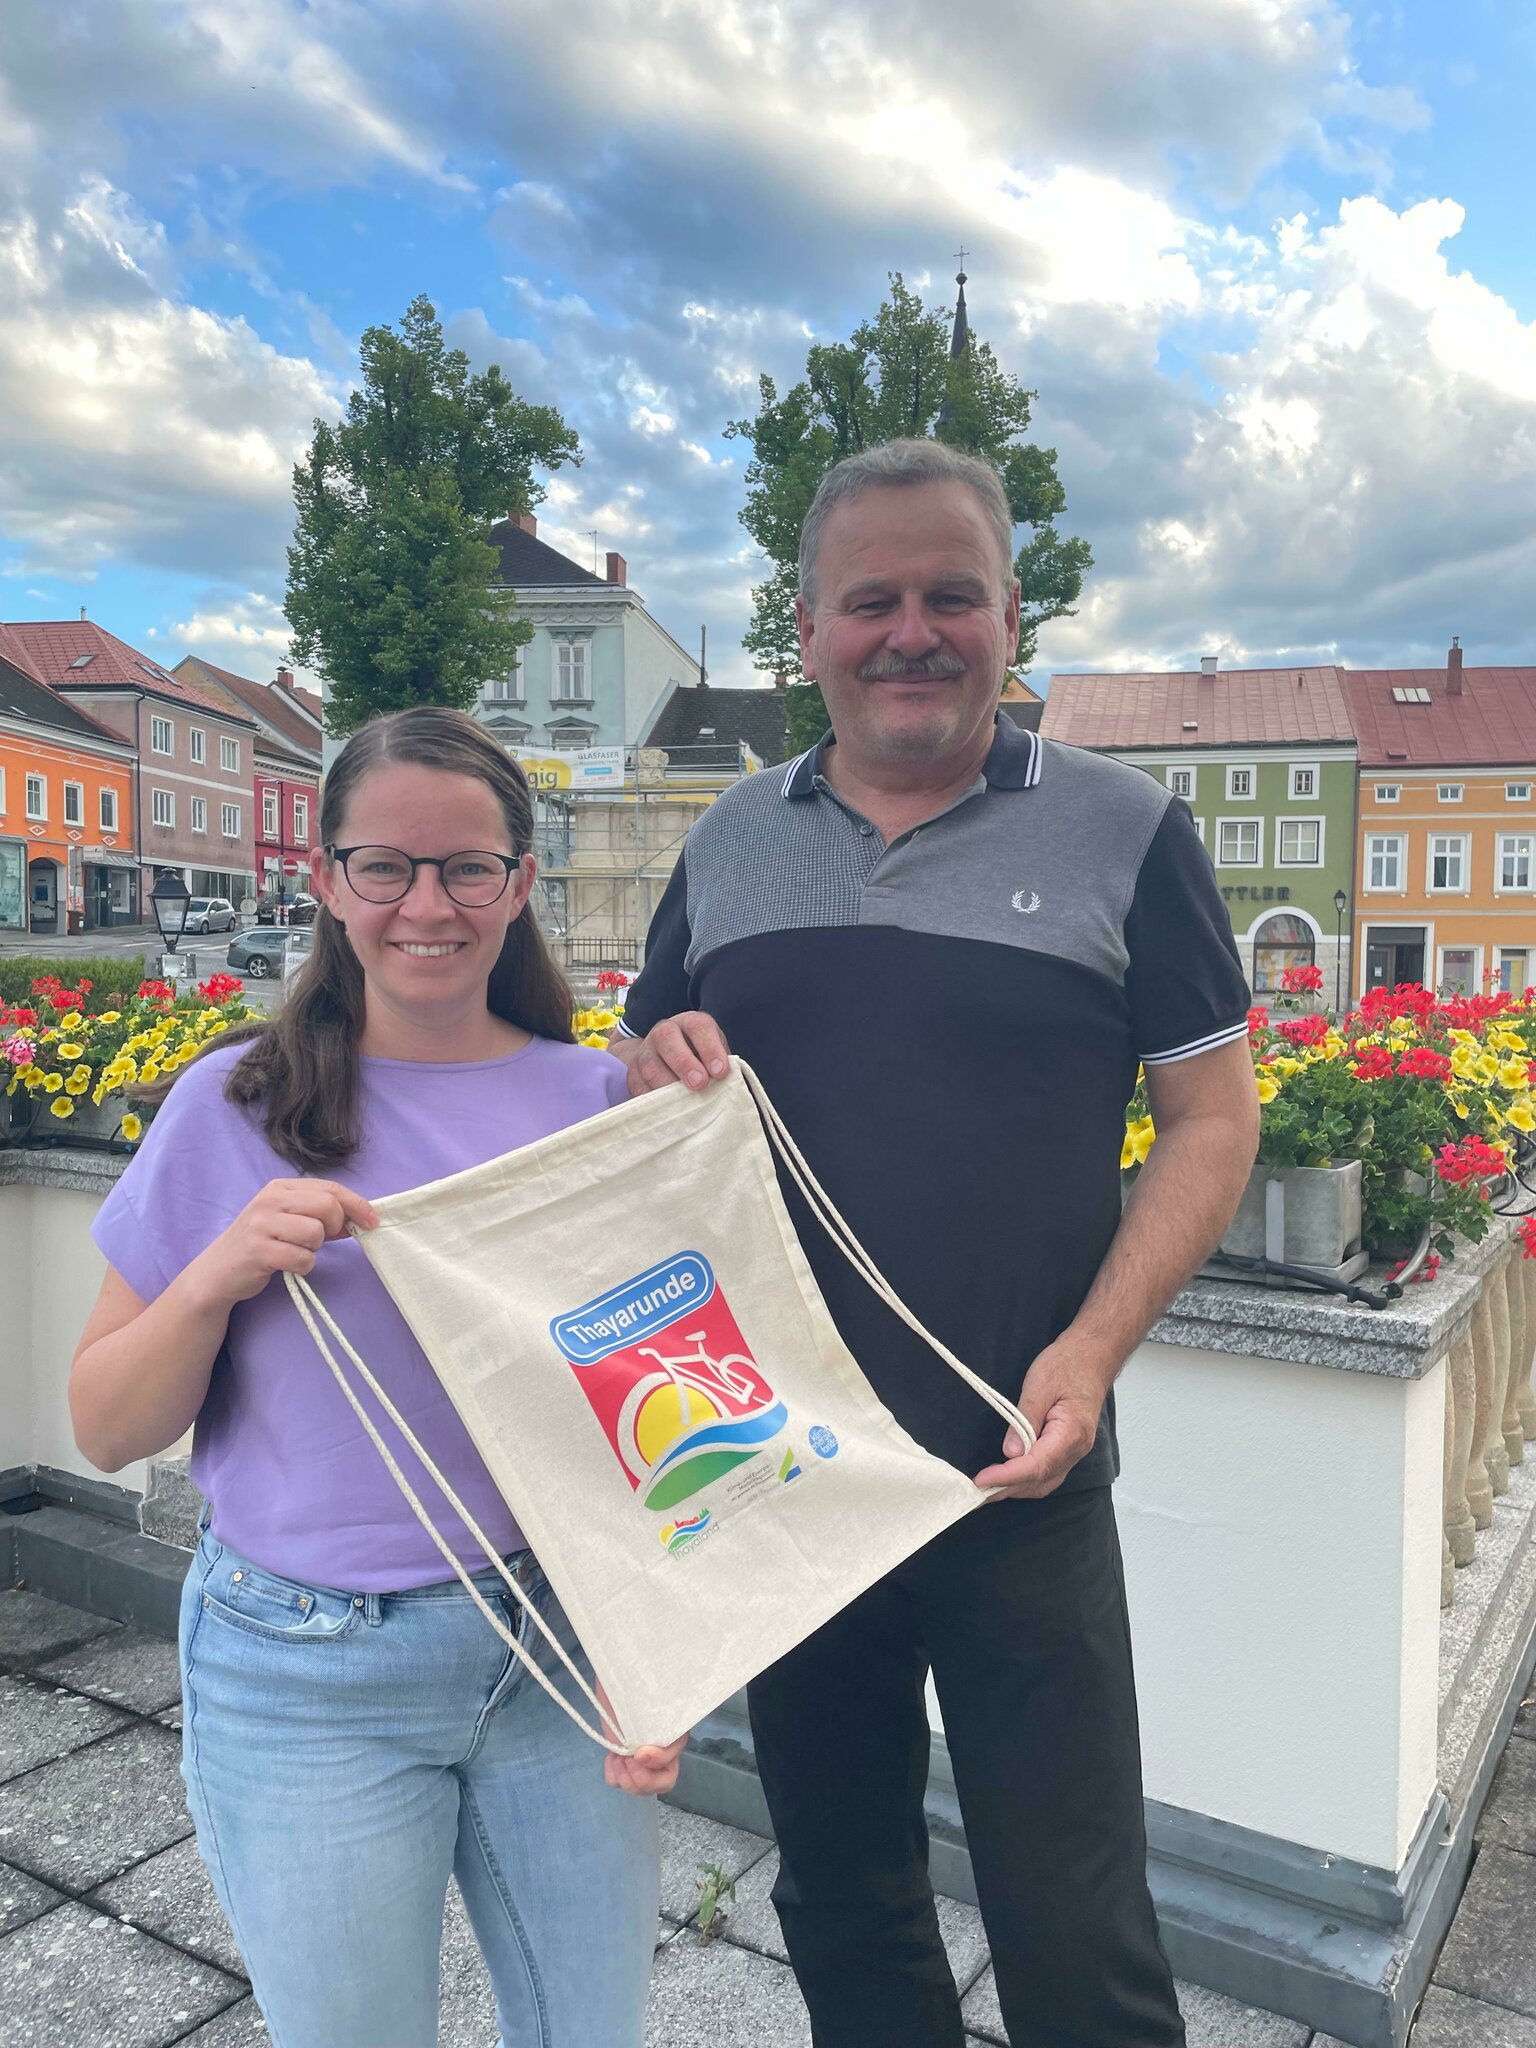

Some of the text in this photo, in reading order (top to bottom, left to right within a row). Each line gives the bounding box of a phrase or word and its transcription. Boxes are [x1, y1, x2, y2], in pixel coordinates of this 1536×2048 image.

[578, 751, 619, 760] GLASFASER
[566, 1272, 696, 1344] Thayarunde
[672, 1521, 720, 1560] Thayaland
